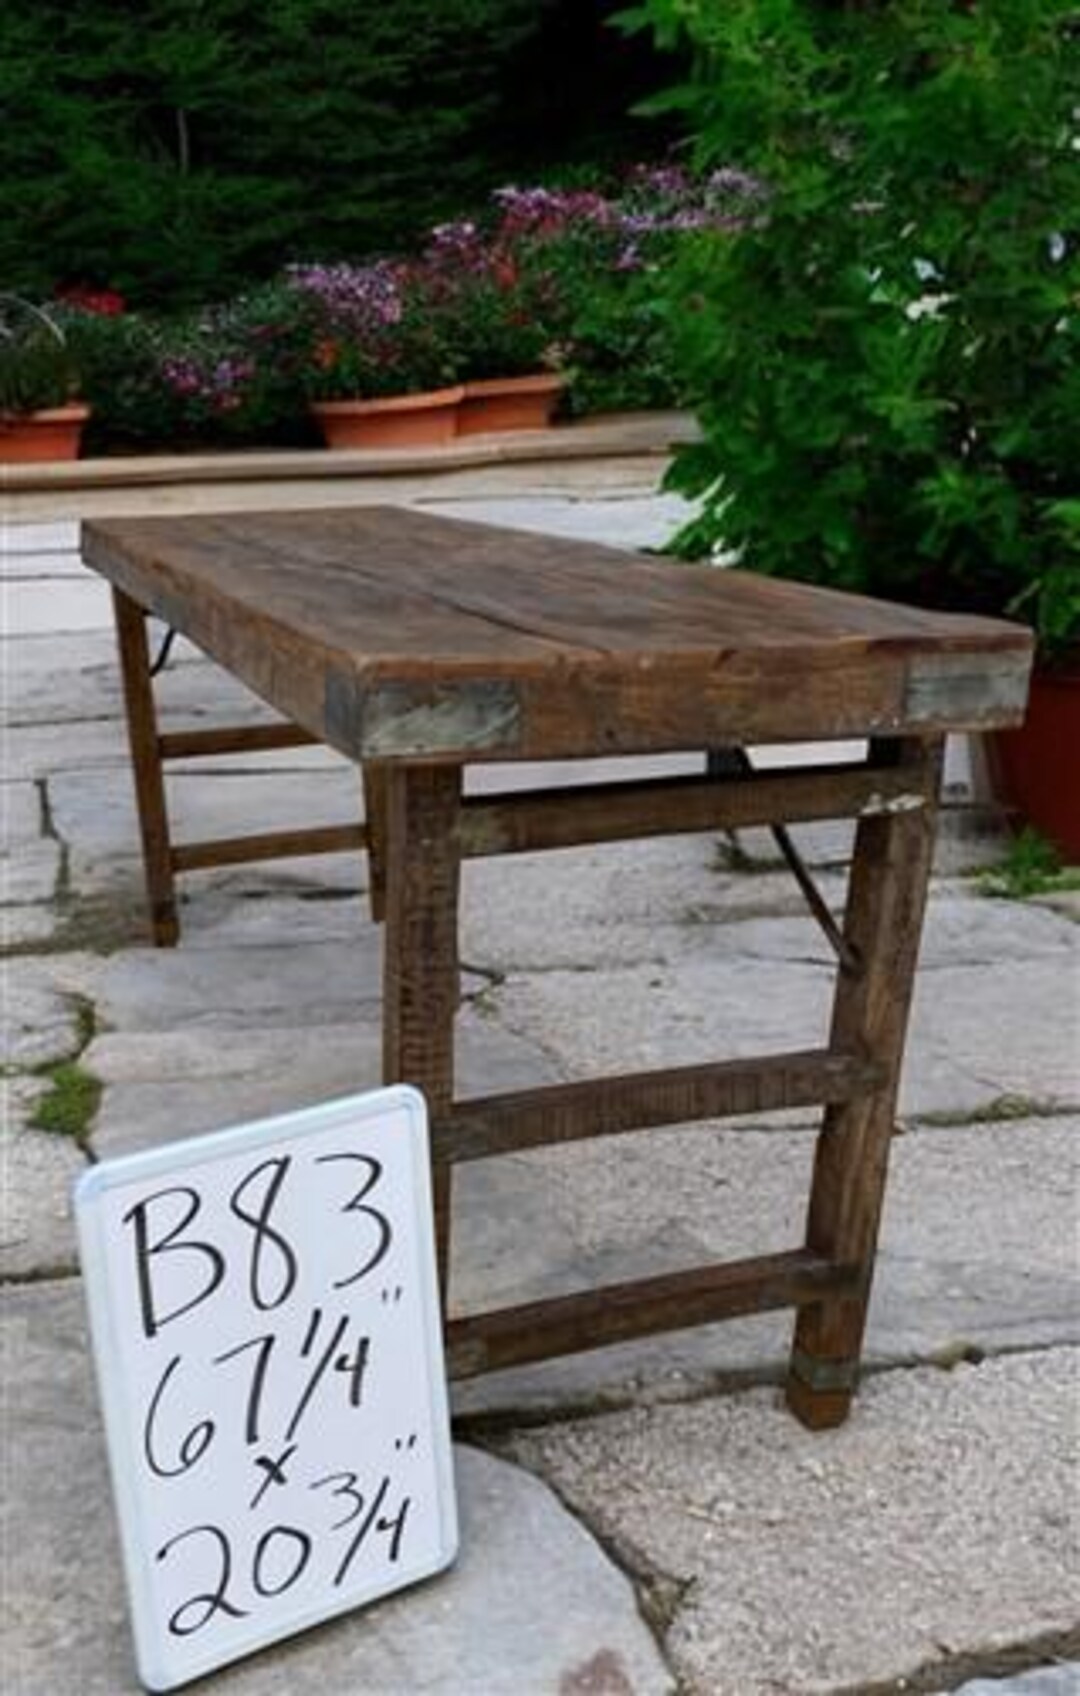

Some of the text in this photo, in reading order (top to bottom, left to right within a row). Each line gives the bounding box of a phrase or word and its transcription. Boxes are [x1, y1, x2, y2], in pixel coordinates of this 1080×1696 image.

[123, 1154, 392, 1338] B83
[145, 1334, 277, 1477] 67
[155, 1524, 313, 1637] 20
